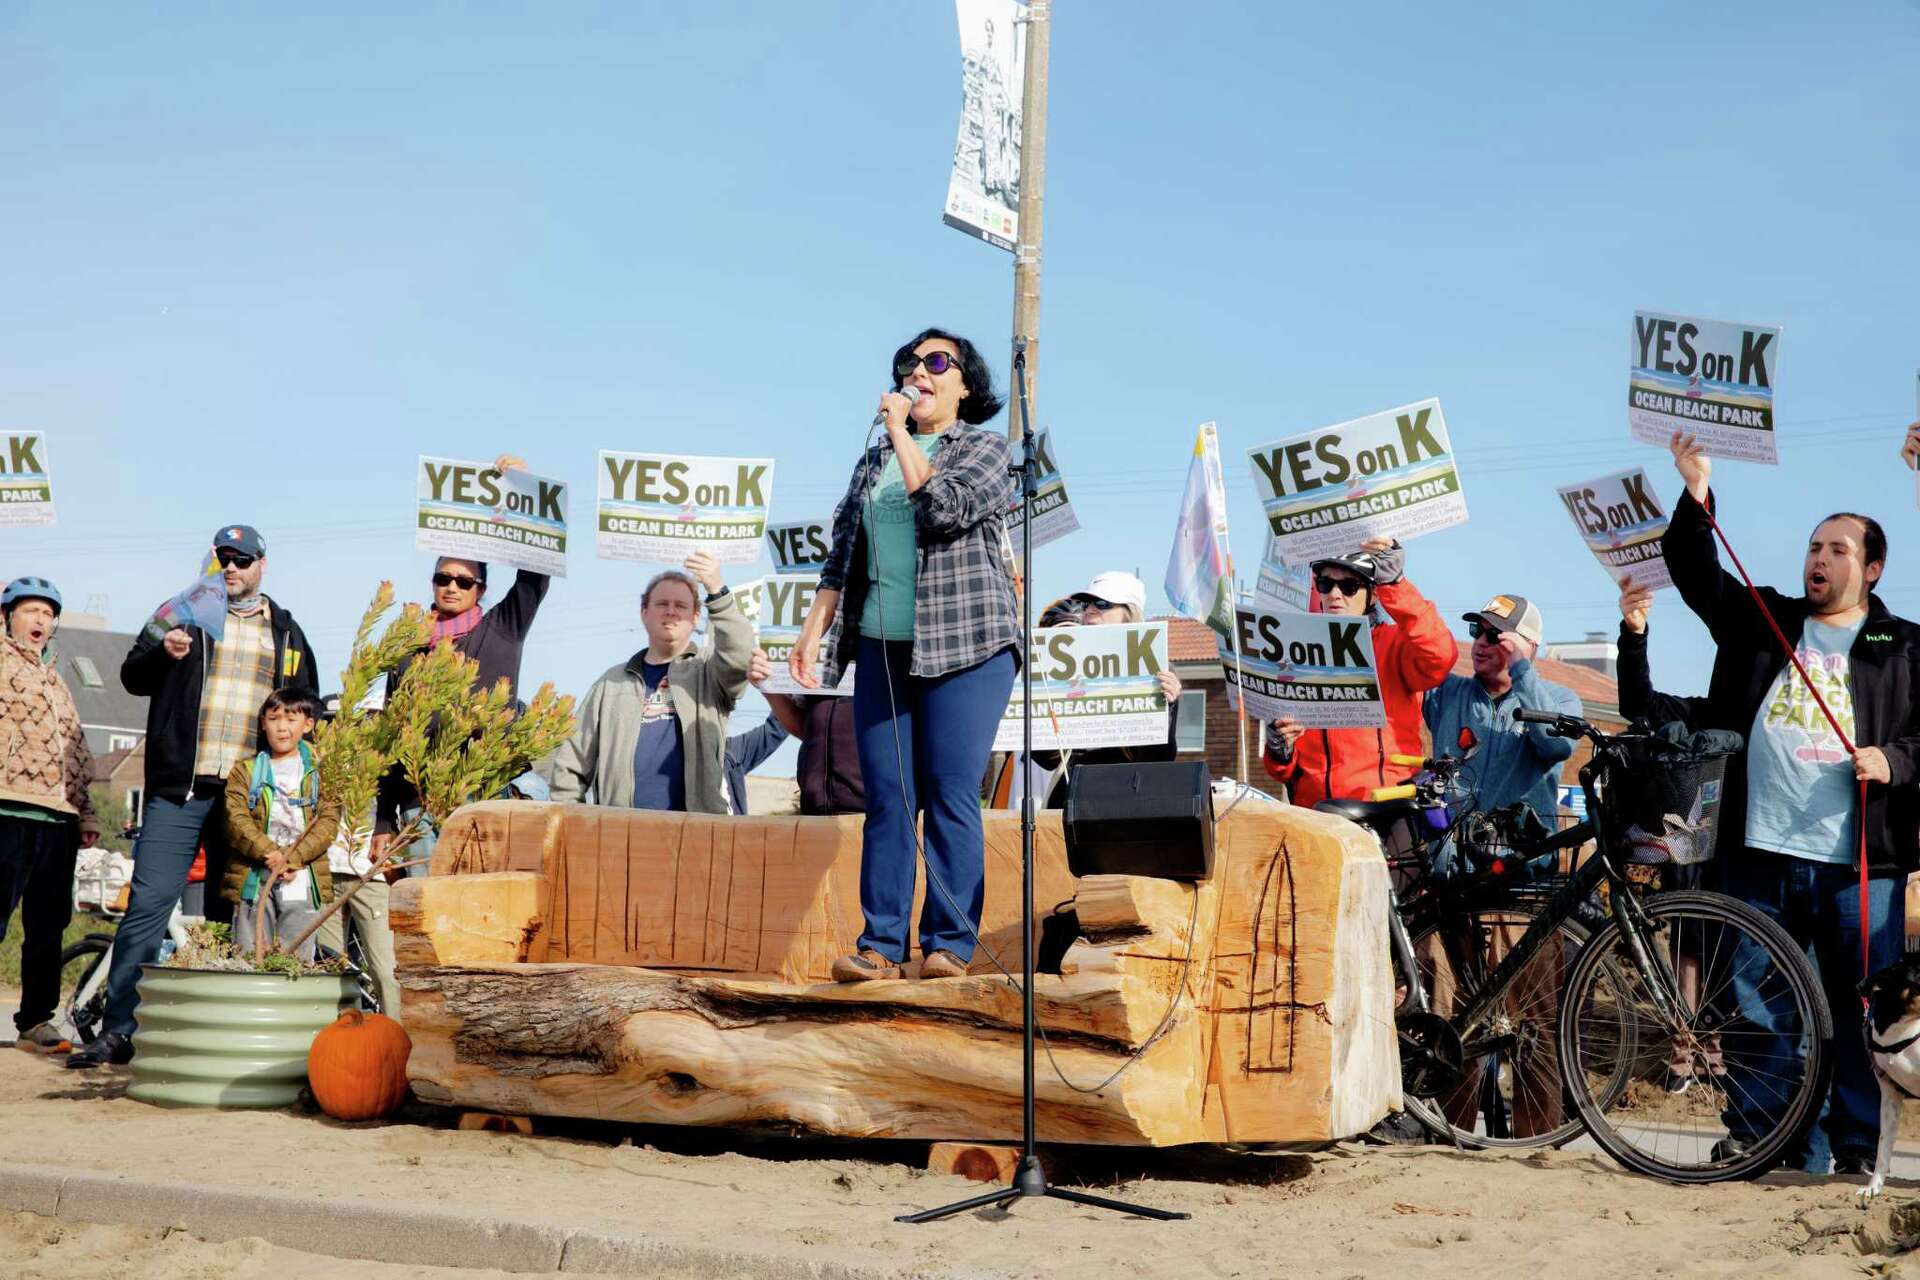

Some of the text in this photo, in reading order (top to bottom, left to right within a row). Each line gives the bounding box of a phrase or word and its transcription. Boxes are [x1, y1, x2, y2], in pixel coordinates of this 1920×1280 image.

[1635, 315, 1774, 387] YES on K
[1635, 390, 1764, 427] OCEAN BEACH PARK
[9, 437, 43, 473] K
[1035, 433, 1056, 479] K
[1251, 407, 1445, 497] YES on K
[1, 489, 43, 502] PARK
[424, 463, 564, 522] YES on K
[605, 457, 767, 506] YES on K
[1034, 491, 1063, 514] PARK
[1560, 473, 1663, 533] YES on K
[1281, 507, 1337, 532] OCEAN
[1337, 494, 1396, 519] BEACH
[1400, 477, 1449, 504] PARK
[426, 516, 561, 550] OCEAN BEACH PARK
[608, 518, 756, 538] OCEAN BEACH PARK
[768, 525, 830, 566] YES
[767, 582, 817, 625] YE
[1021, 628, 1162, 681] ES on K
[1224, 612, 1369, 668] ES on K
[1053, 700, 1108, 716] BEACH
[1112, 697, 1158, 712] PARK
[1267, 681, 1317, 700] BEACH
[1322, 686, 1370, 700] PARK
